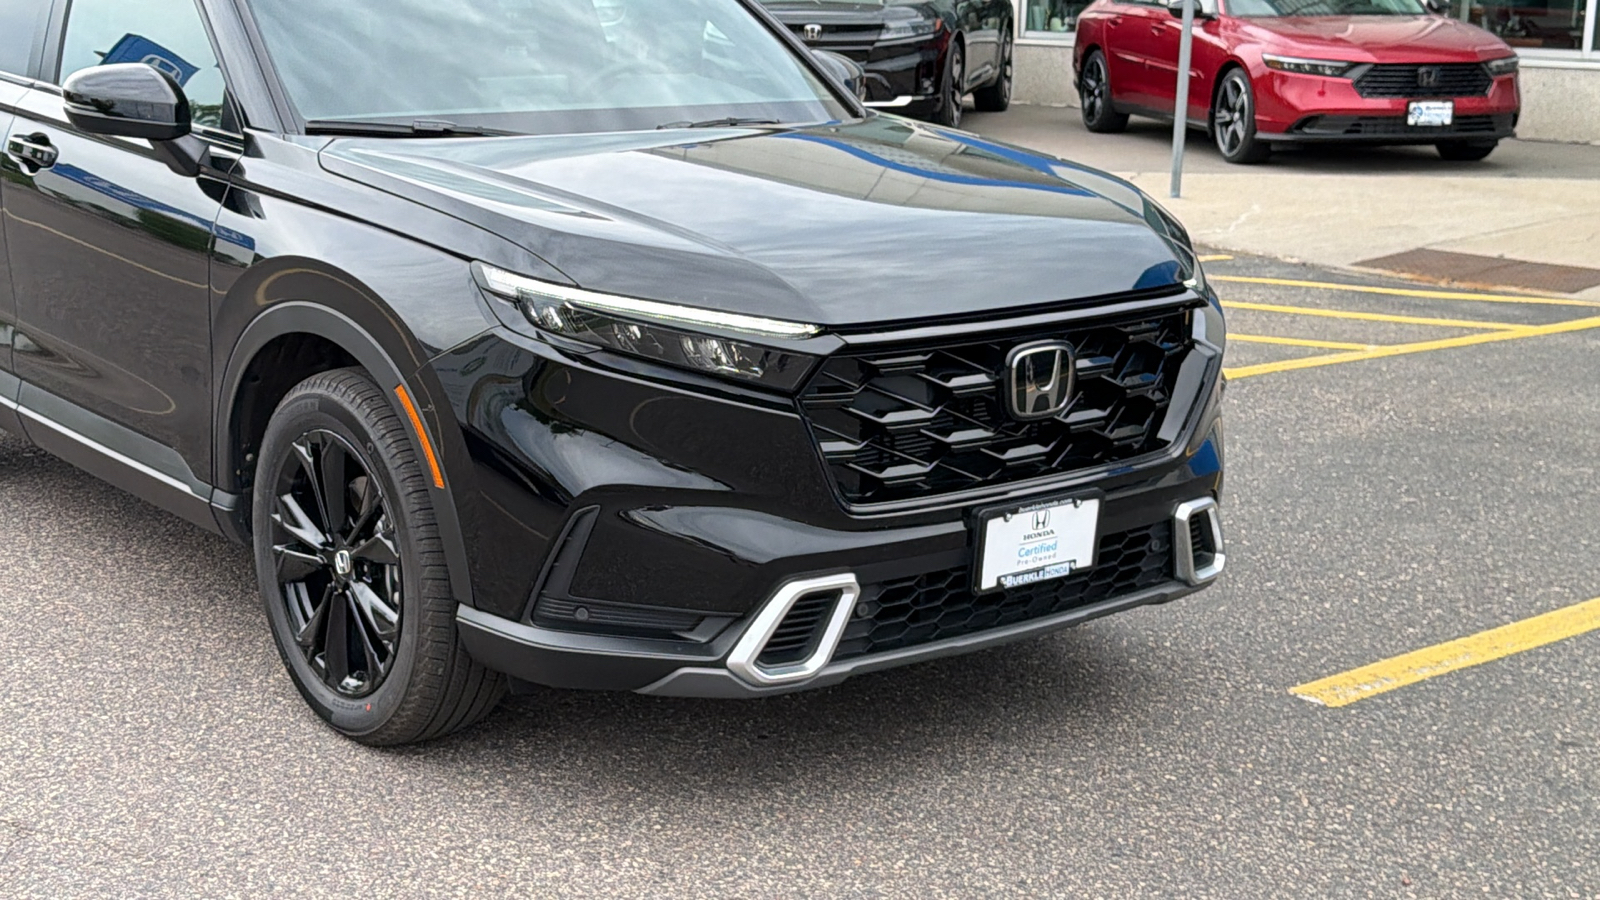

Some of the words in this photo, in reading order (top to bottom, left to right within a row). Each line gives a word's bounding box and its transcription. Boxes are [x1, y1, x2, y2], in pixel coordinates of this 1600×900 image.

[1023, 529, 1055, 541] HONDA
[1018, 540, 1058, 558] Certified
[1006, 569, 1045, 587] BUERKLE
[1045, 565, 1068, 577] HONDA
